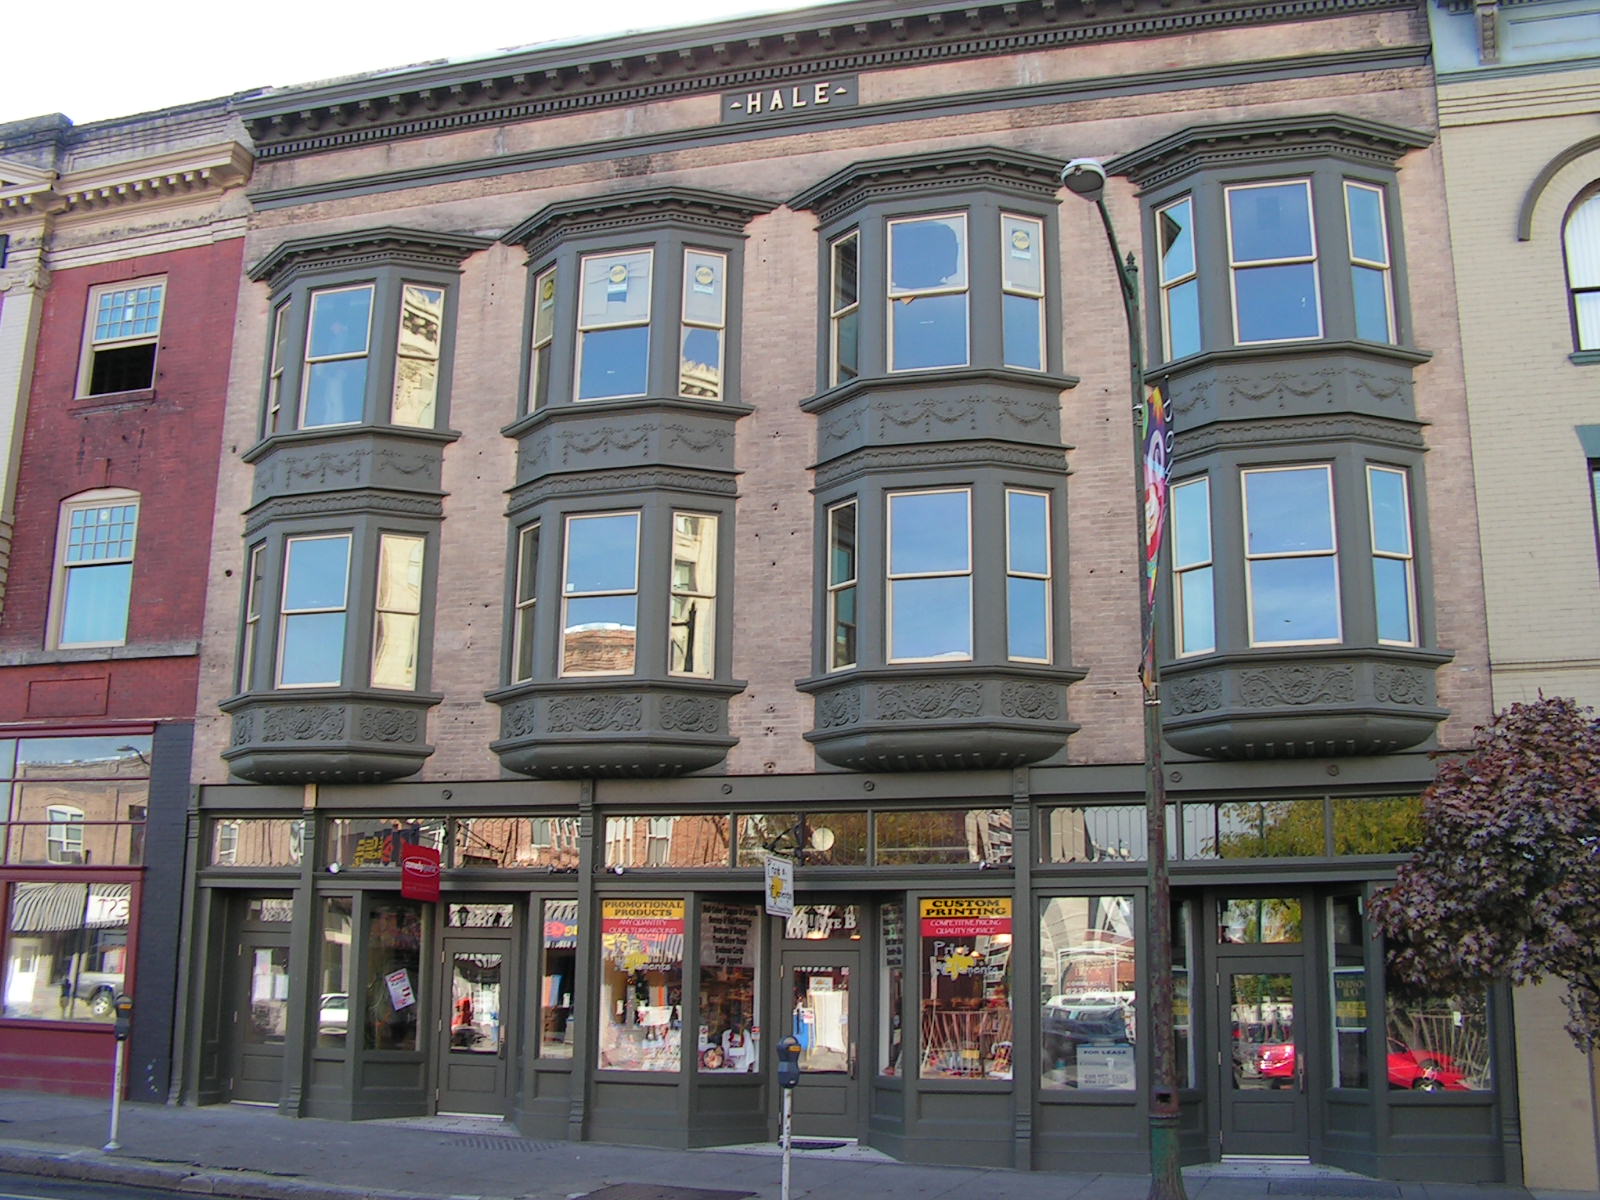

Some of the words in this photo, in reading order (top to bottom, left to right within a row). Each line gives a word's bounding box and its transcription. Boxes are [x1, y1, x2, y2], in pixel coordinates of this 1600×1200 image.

[746, 83, 830, 114] HALE
[604, 901, 682, 909] PROMOTIONAL
[932, 900, 1000, 908] CUSTOM
[614, 908, 672, 916] PRODUCTS
[926, 907, 1007, 916] PRINTING
[844, 914, 856, 929] B
[930, 919, 975, 927] COMPETITIVE
[975, 919, 1002, 927] PRICING
